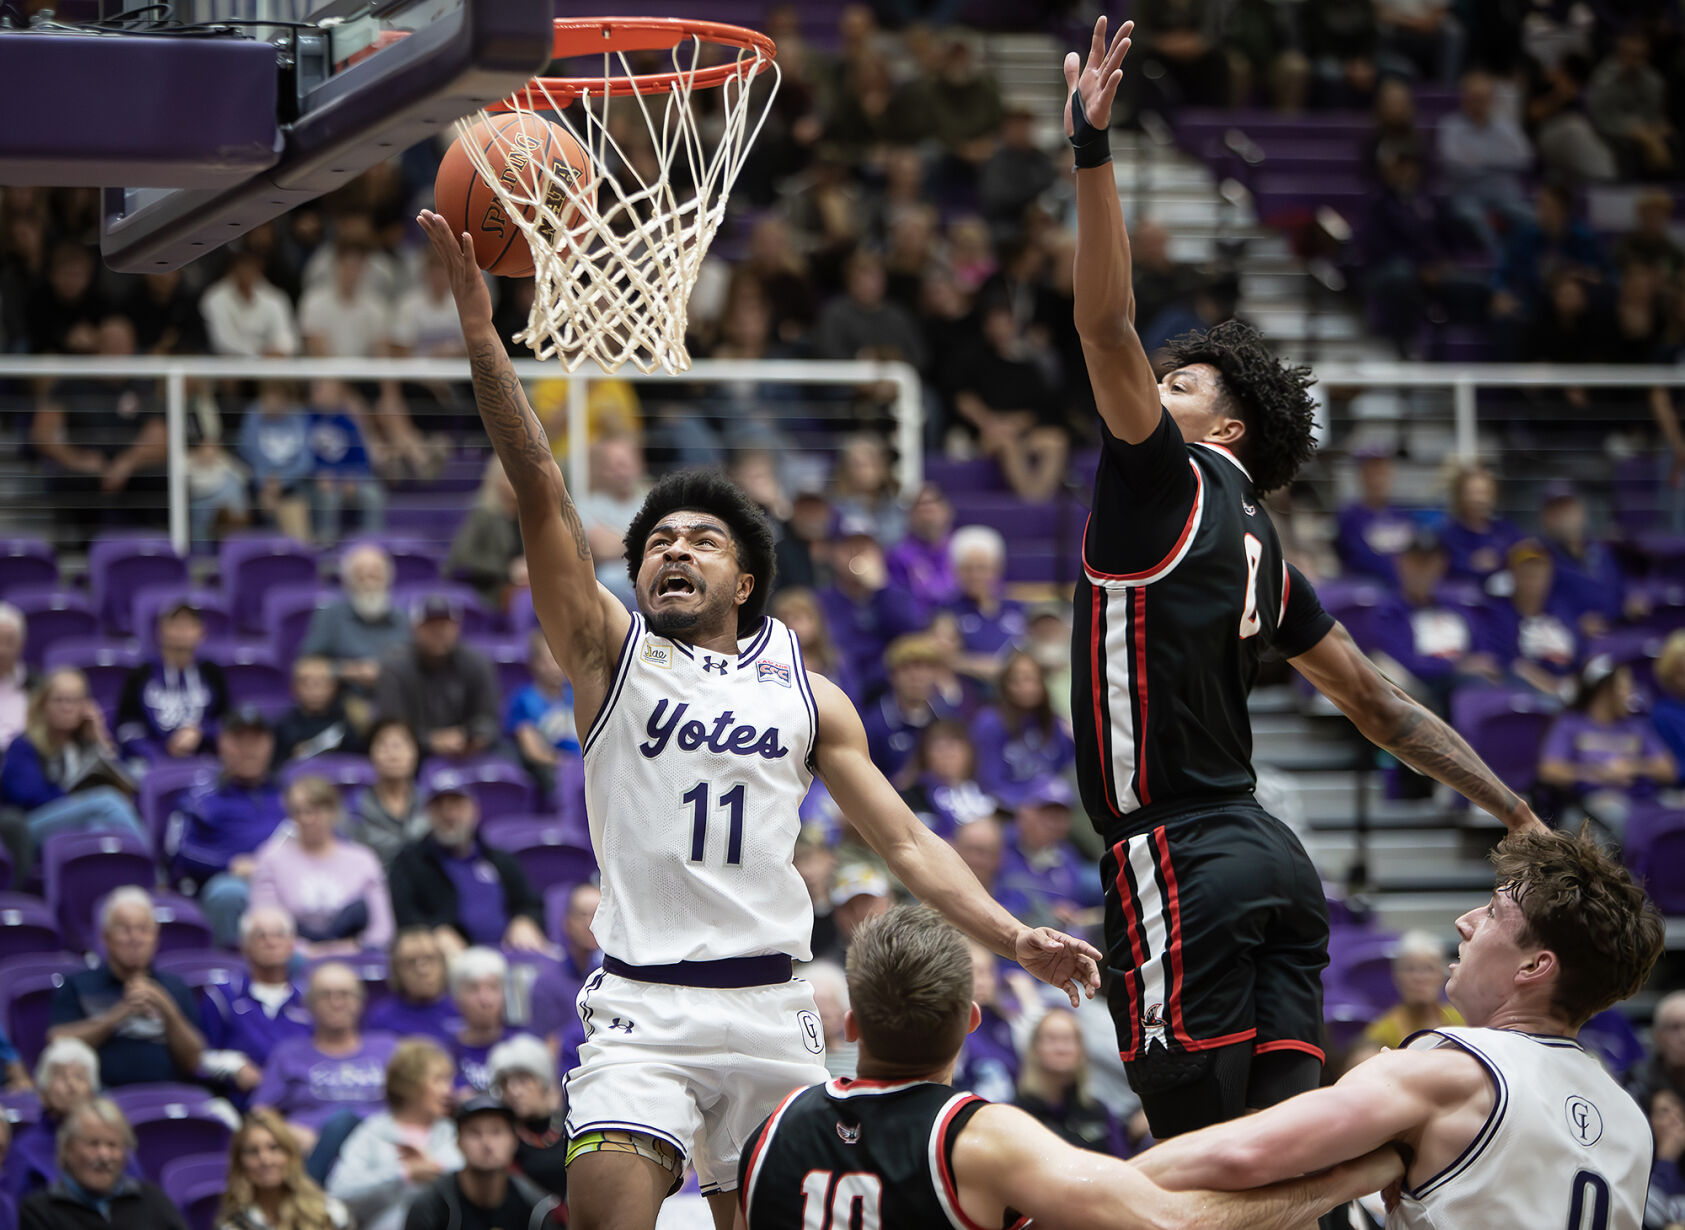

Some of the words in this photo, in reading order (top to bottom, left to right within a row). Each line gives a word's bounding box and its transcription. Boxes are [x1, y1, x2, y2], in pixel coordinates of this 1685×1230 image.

[639, 698, 790, 760] Yotes
[681, 780, 747, 868] 11
[800, 1168, 882, 1230] 10
